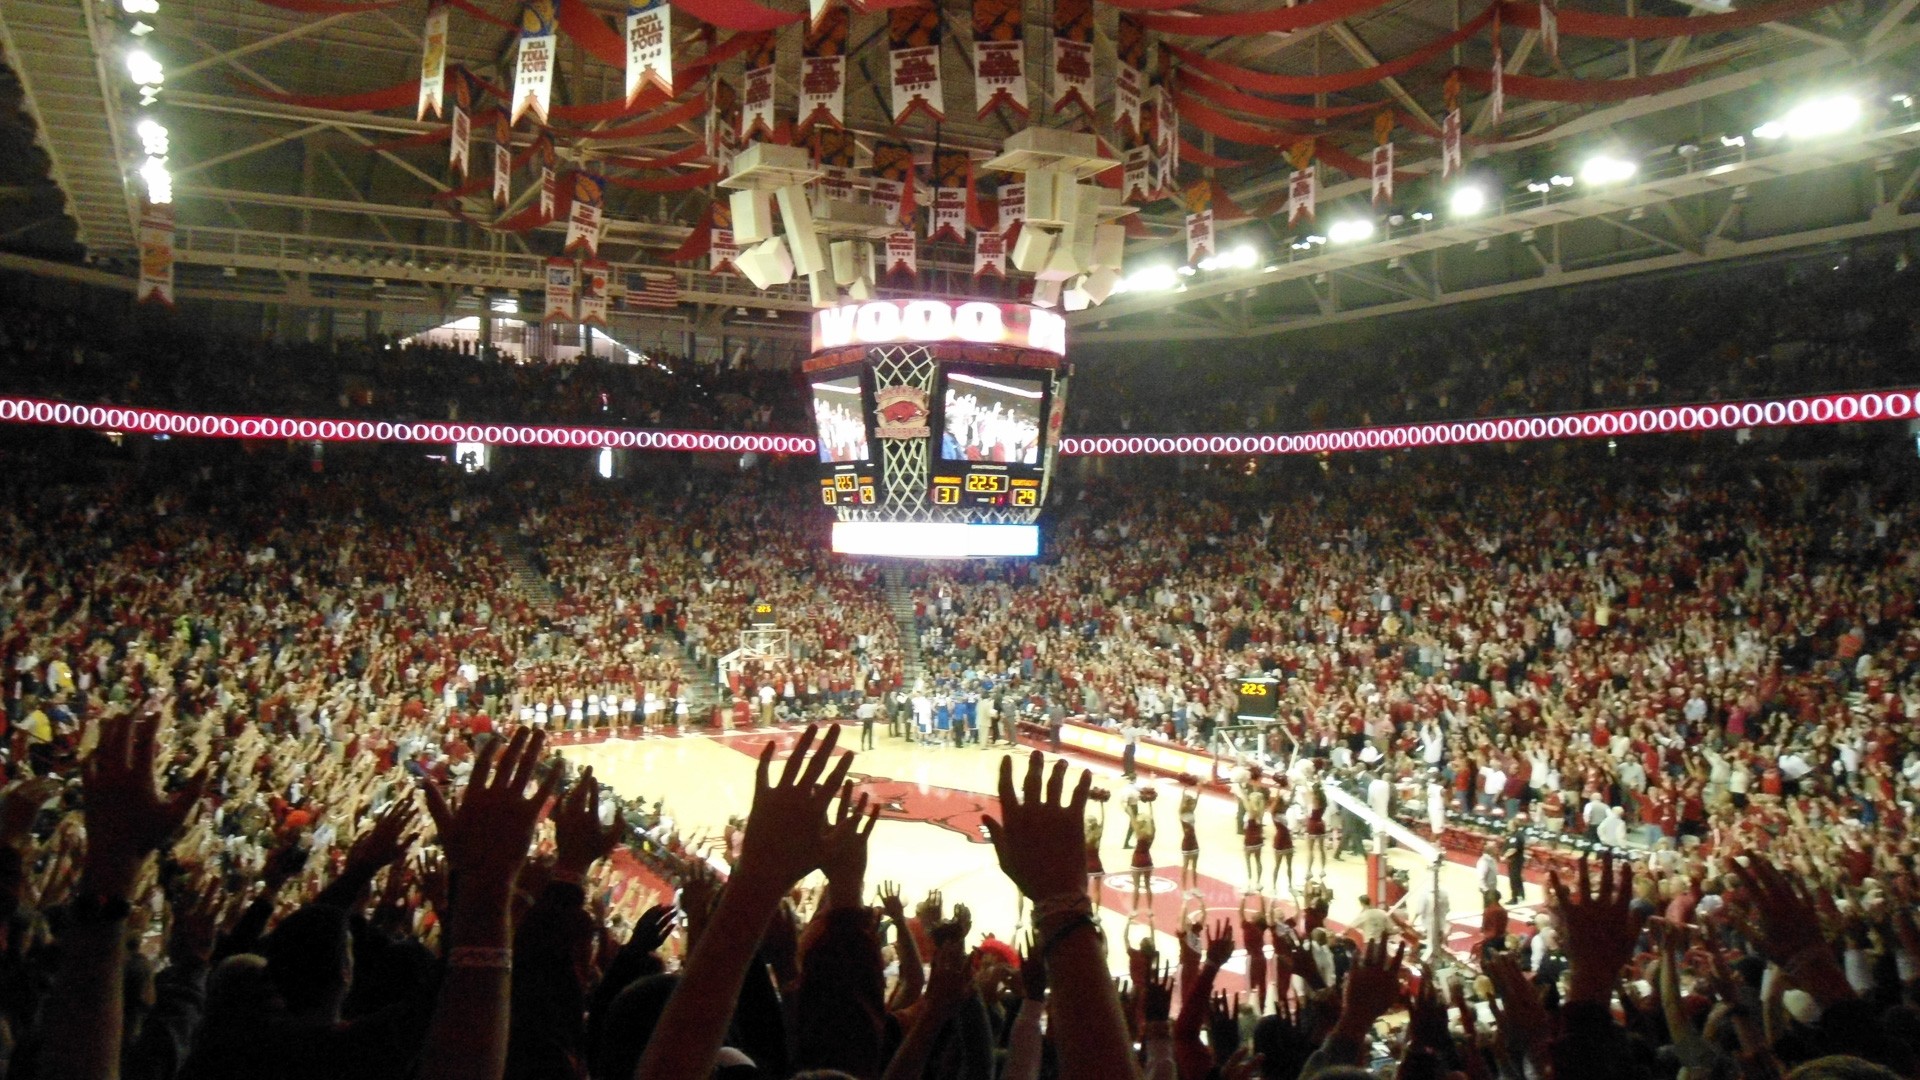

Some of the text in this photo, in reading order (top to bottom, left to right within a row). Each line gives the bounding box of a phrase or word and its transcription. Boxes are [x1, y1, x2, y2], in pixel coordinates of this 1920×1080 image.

[630, 20, 664, 41] FINAL
[632, 33, 662, 52] FOUR
[520, 49, 549, 62] FINAL
[521, 61, 547, 73] FOUR
[820, 301, 1001, 347] WOOO
[941, 488, 959, 503] 31
[1017, 490, 1036, 504] 29
